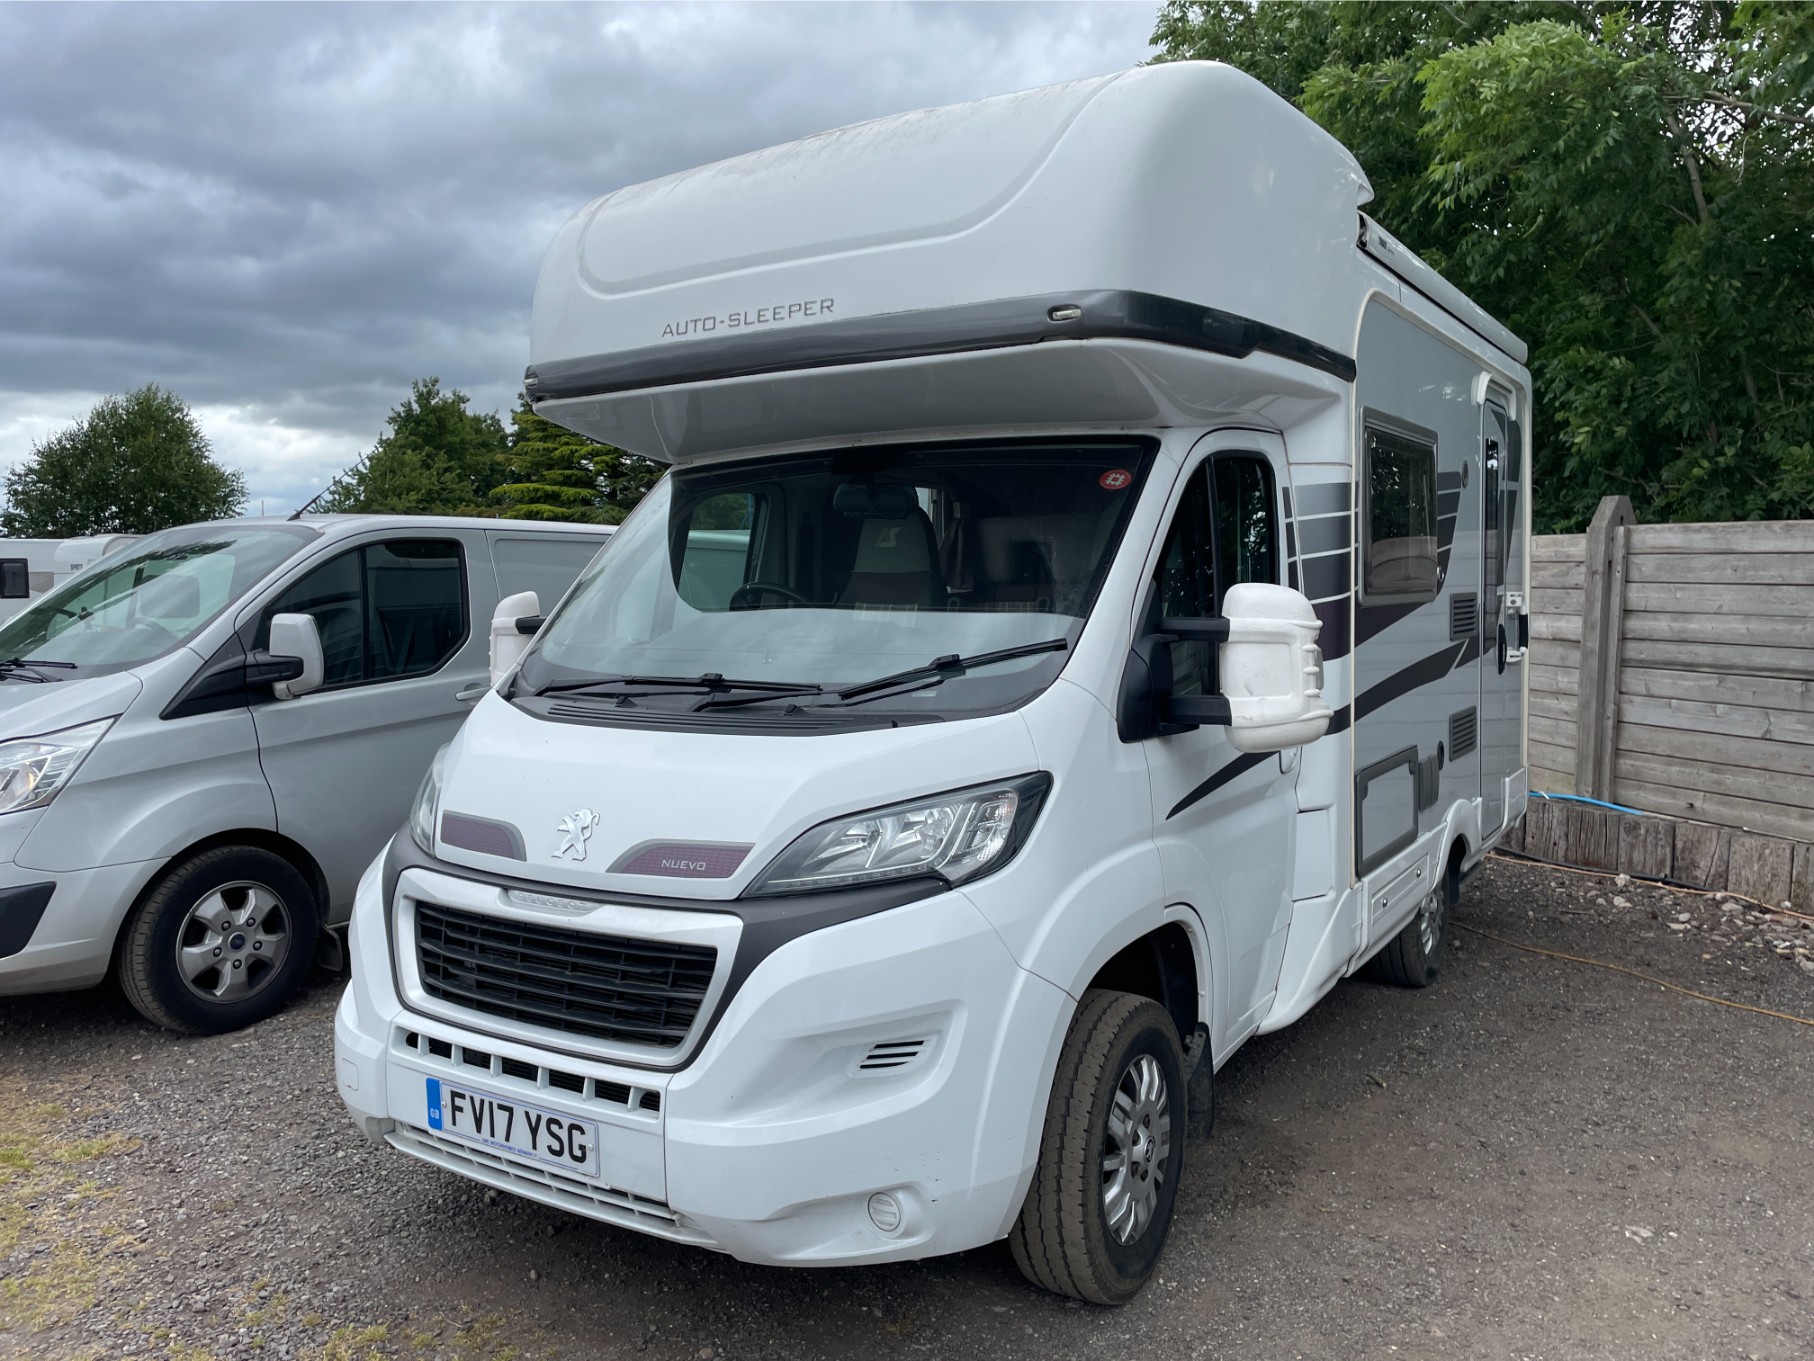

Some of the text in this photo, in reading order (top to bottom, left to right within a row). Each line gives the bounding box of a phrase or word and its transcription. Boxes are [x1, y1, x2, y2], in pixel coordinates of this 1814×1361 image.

[662, 298, 834, 338] AUTO-SLEEPER
[661, 859, 706, 870] NUEVO
[430, 1107, 440, 1119] GB
[450, 1089, 587, 1164] FV17 YSG
